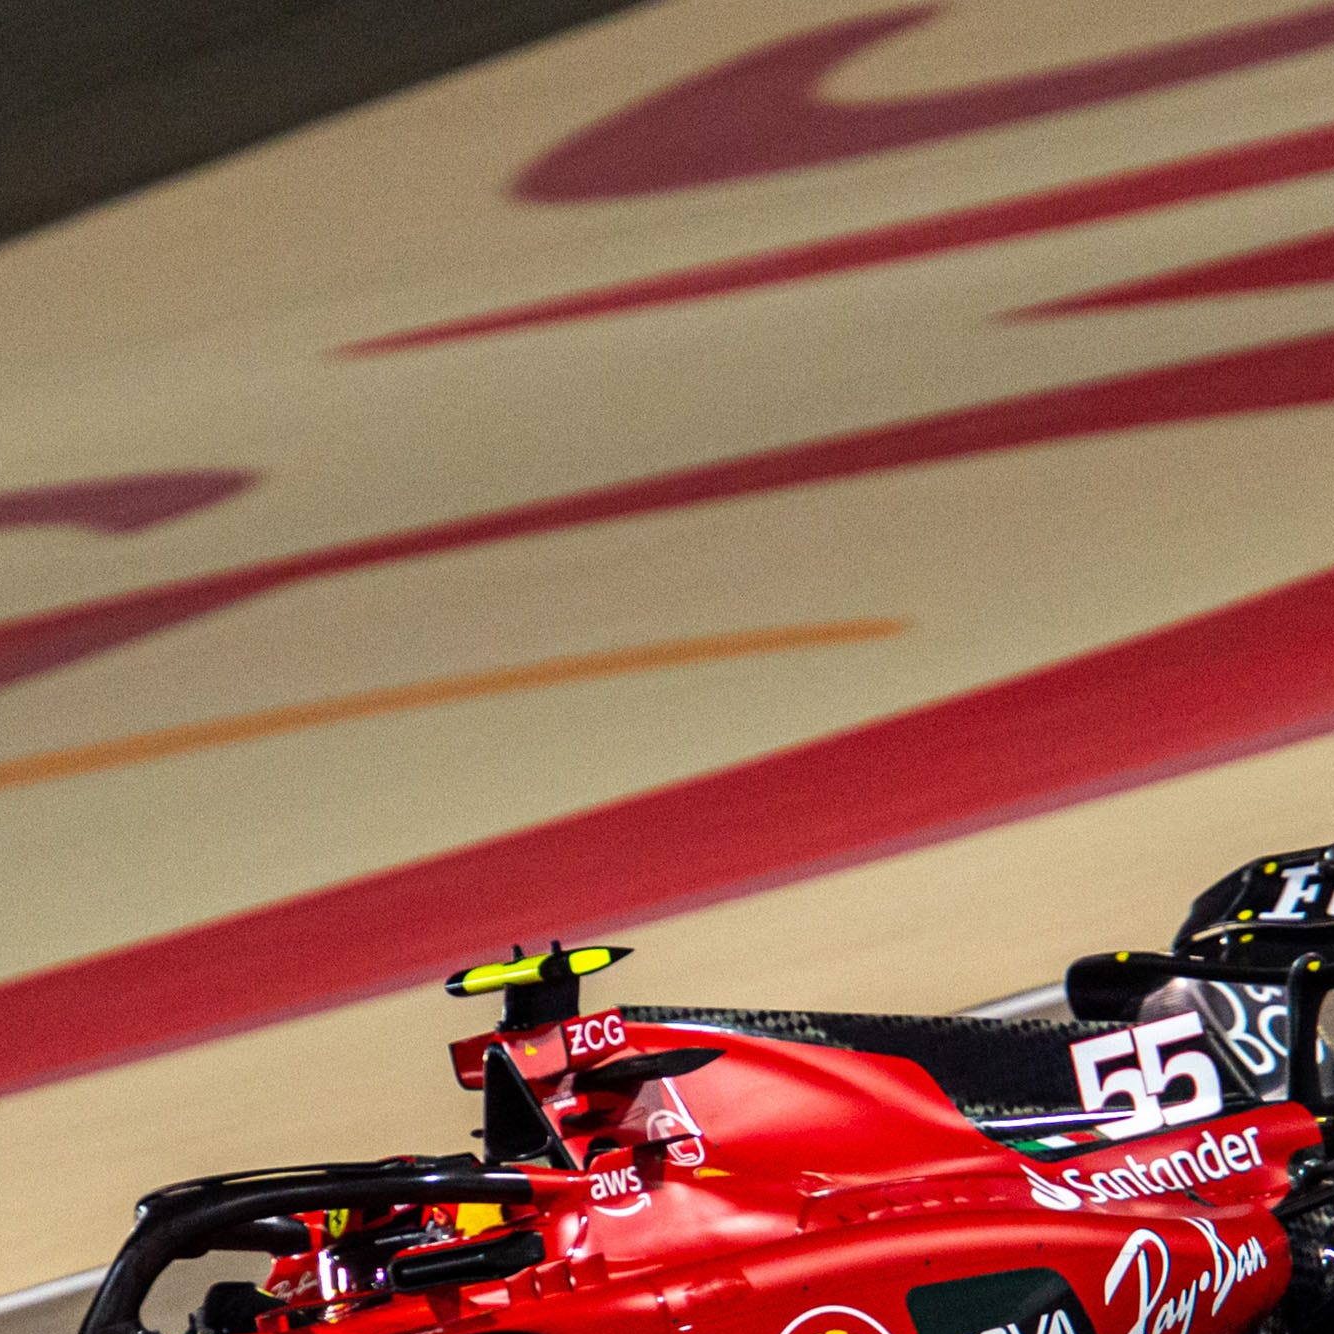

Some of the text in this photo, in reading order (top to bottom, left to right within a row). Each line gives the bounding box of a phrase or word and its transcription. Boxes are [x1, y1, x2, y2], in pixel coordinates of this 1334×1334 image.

[567, 1014, 626, 1056] ZCG
[1069, 1011, 1223, 1141] 55
[589, 1165, 643, 1201] aws
[1062, 1127, 1264, 1204] Santander
